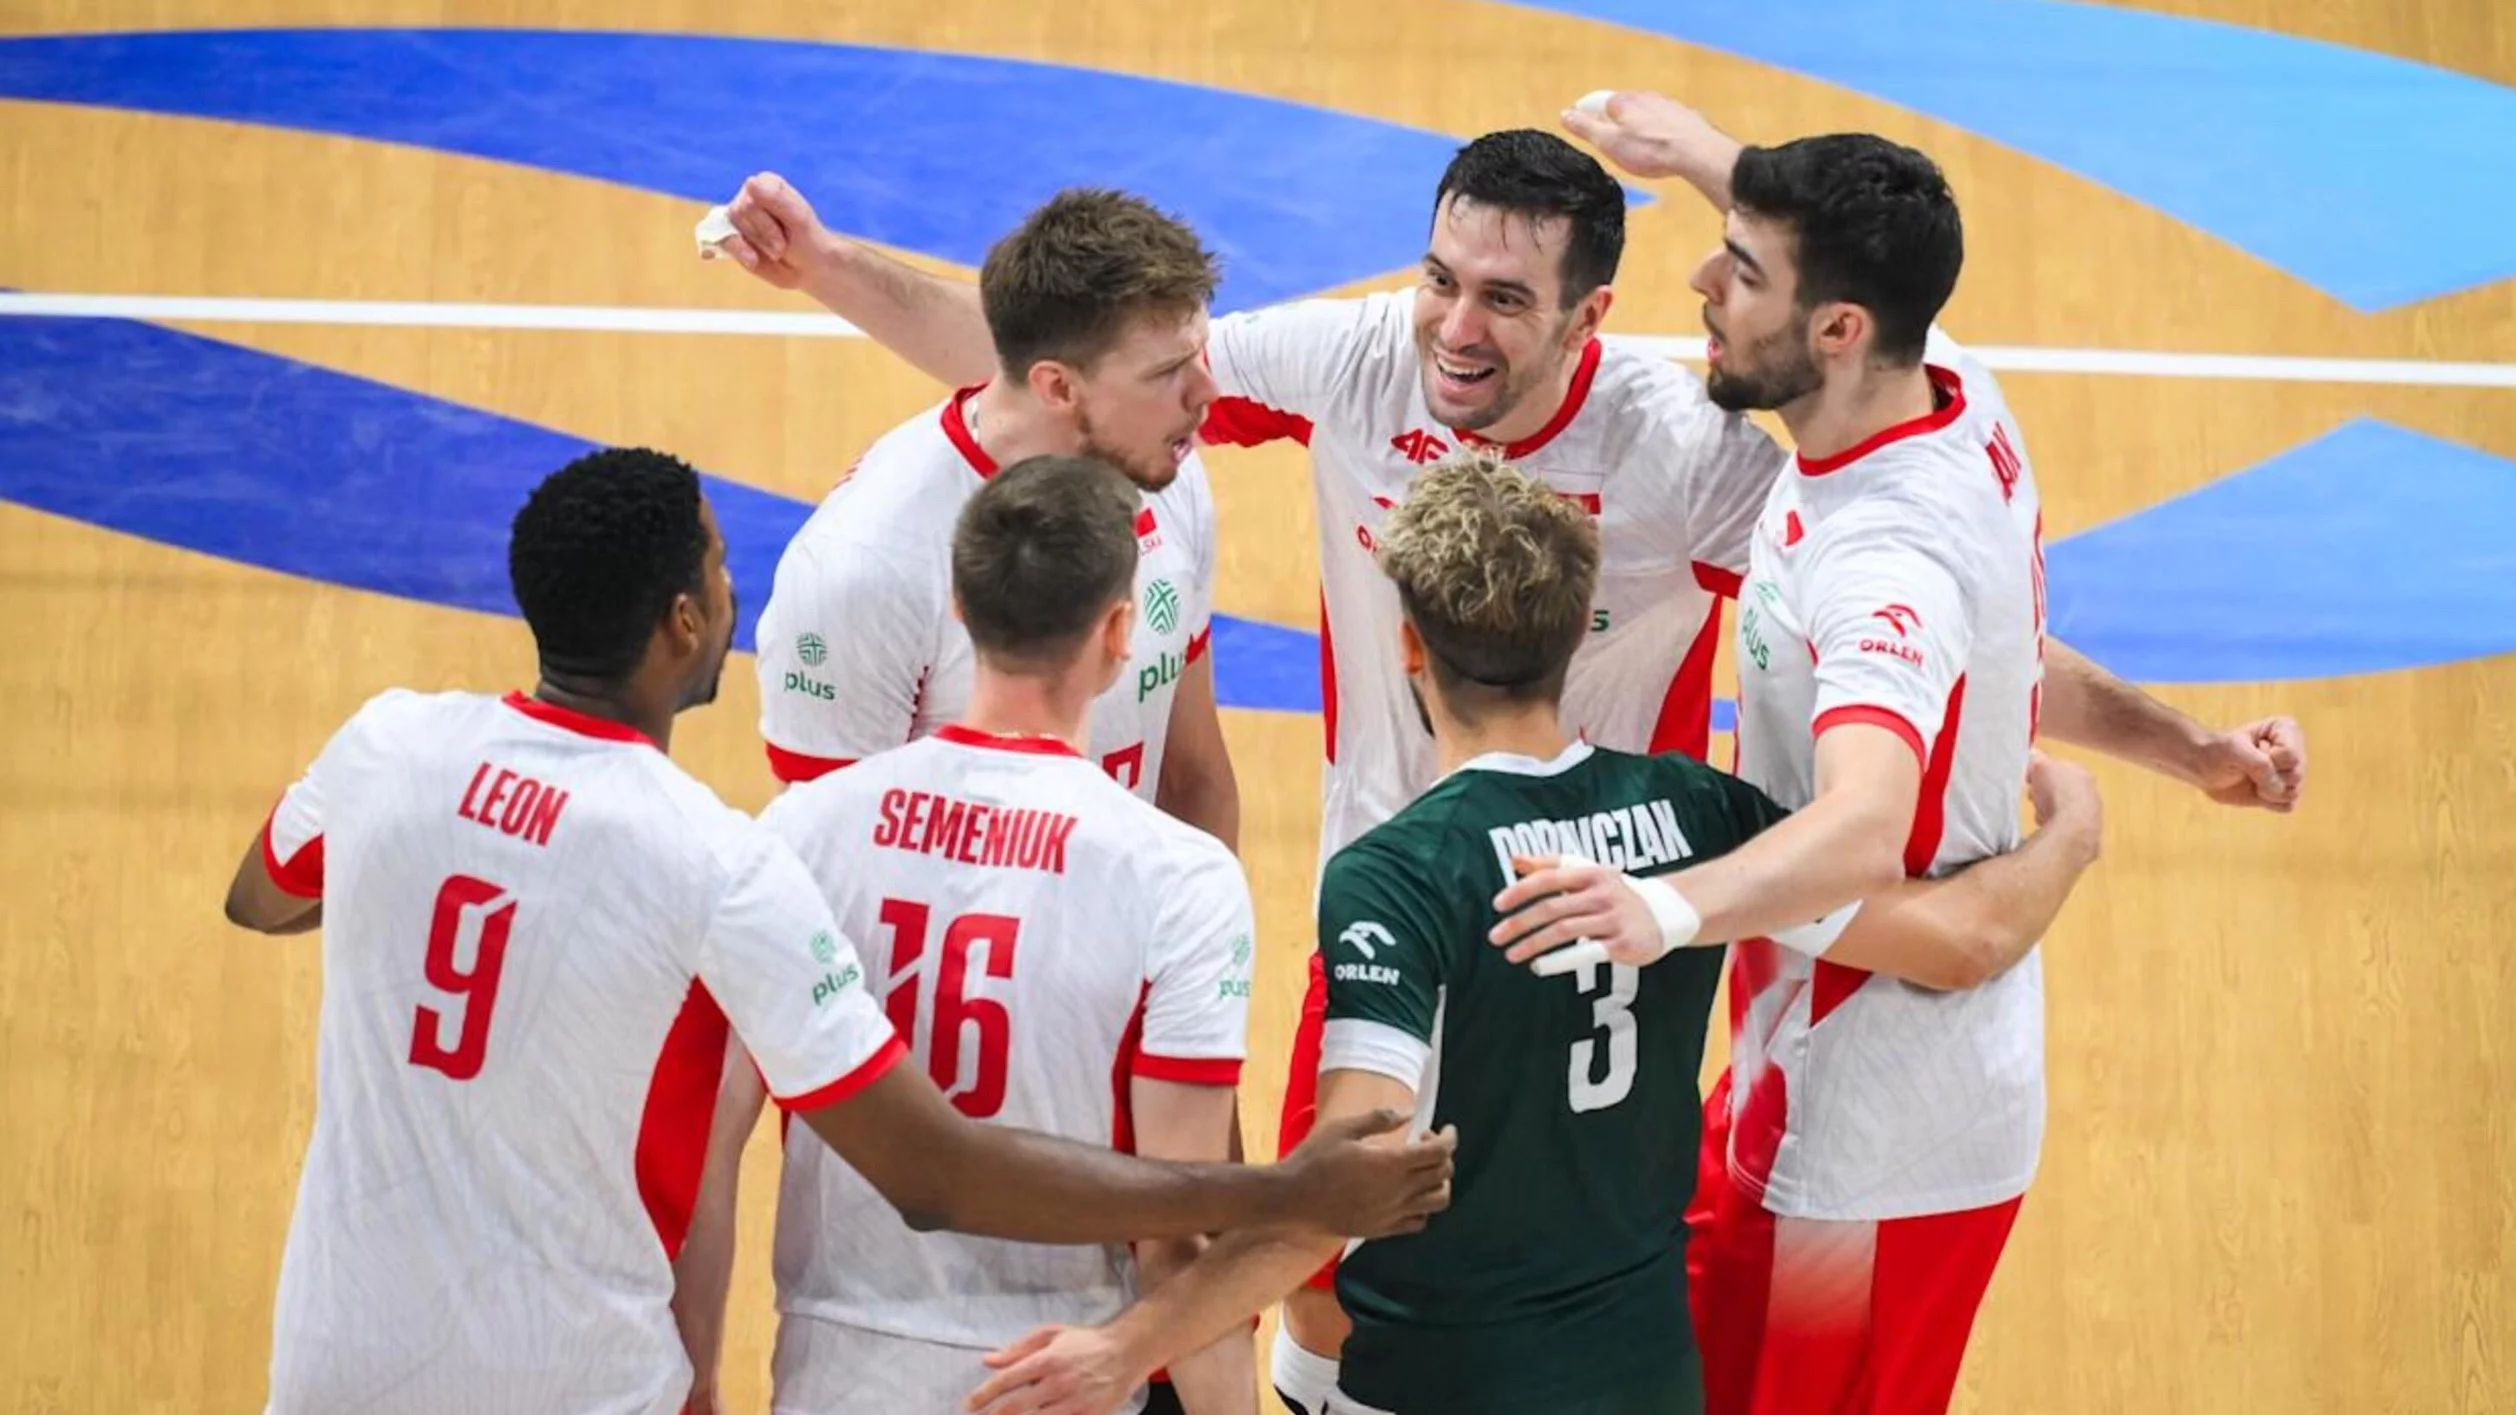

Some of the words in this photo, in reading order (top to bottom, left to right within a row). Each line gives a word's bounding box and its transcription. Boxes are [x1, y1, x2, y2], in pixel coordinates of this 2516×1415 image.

[784, 670, 836, 701] plus
[1138, 651, 1184, 703] plu
[1859, 639, 1923, 668] ORLEN
[457, 762, 570, 848] LEON
[873, 788, 1079, 875] SEMENIUK
[408, 873, 519, 1081] 9
[812, 962, 860, 1006] plus
[879, 897, 1022, 1118] 16
[1334, 963, 1400, 986] ORLEN
[1568, 938, 1640, 1114] 3
